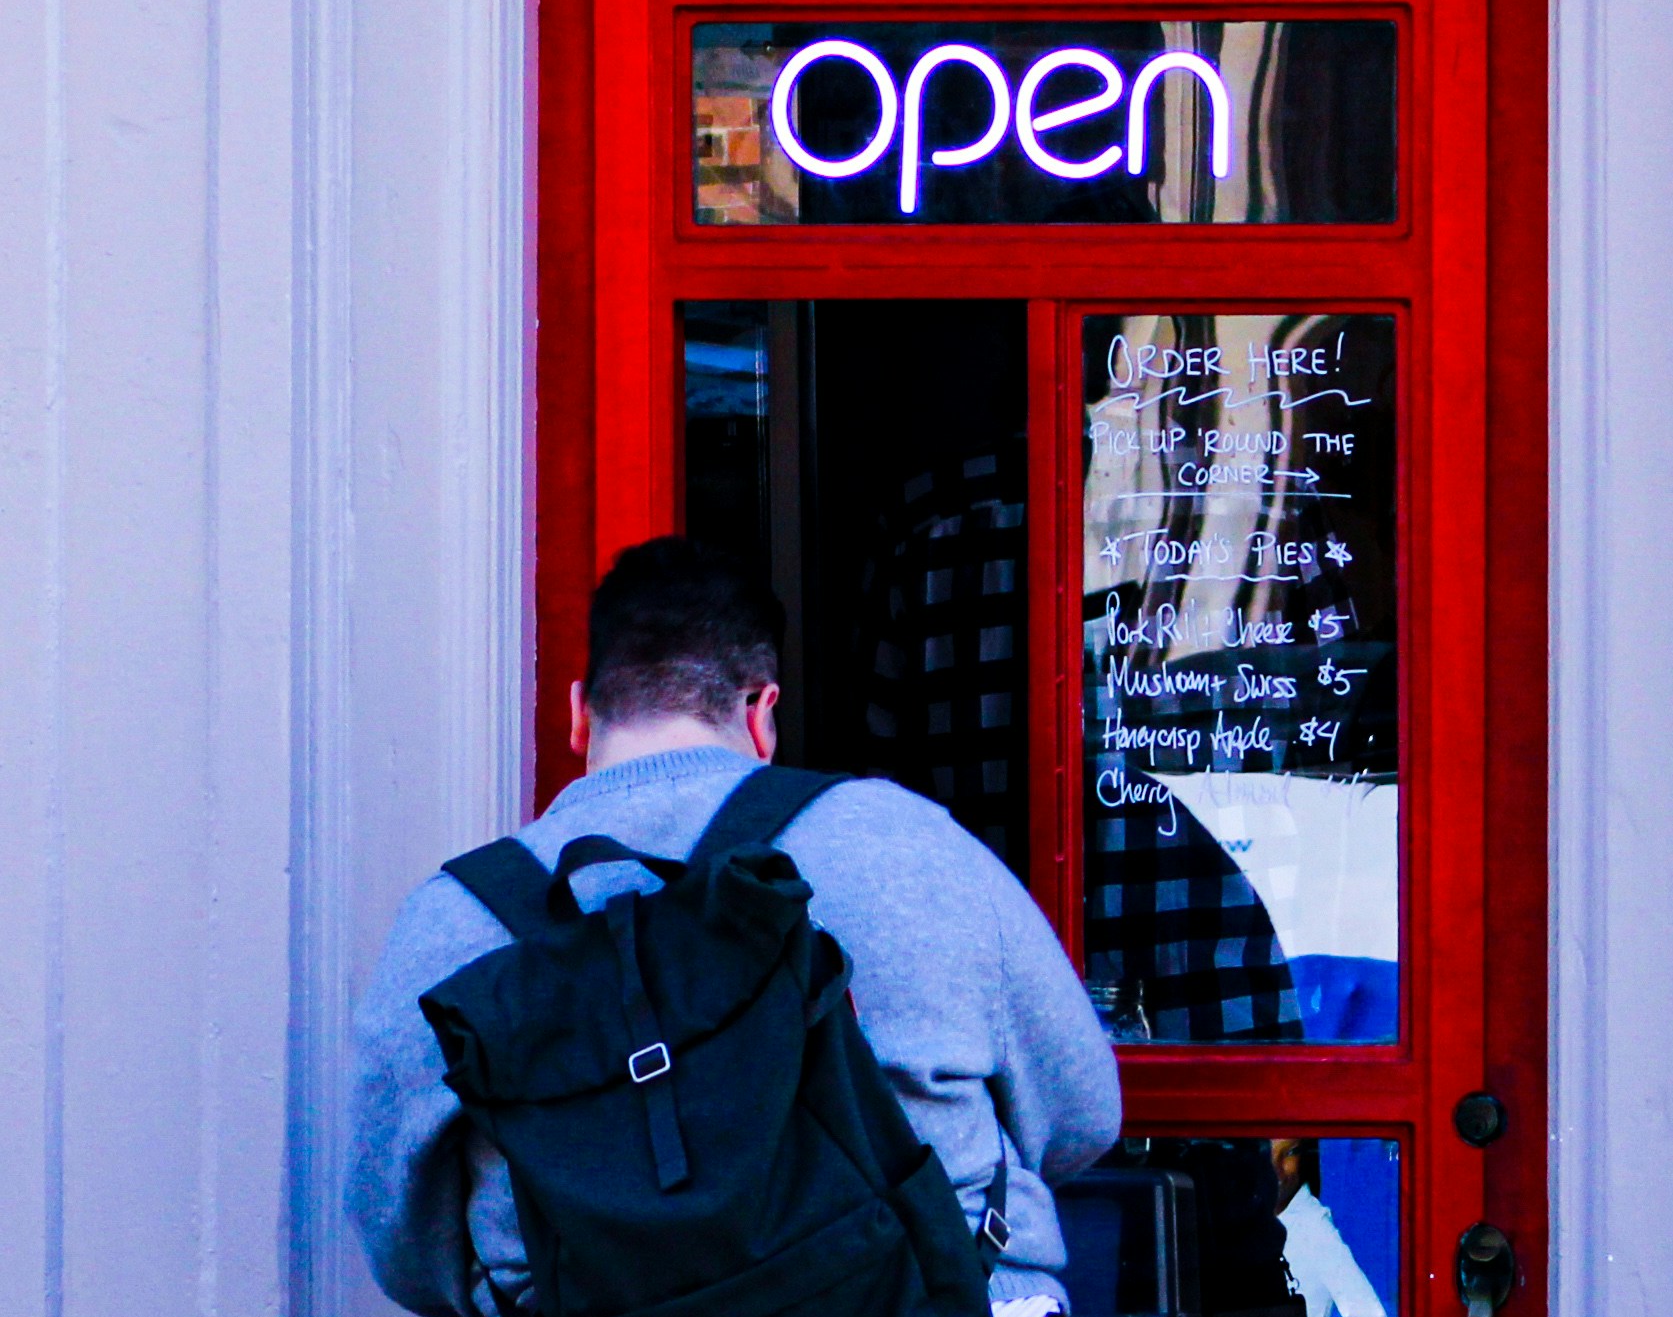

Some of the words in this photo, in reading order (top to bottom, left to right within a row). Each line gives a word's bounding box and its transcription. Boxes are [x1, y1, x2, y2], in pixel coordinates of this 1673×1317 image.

[1107, 334, 1231, 387] ORDER
[1248, 331, 1344, 382] HERE!
[1090, 421, 1140, 455] PICK
[1150, 428, 1186, 453] UP
[1303, 433, 1354, 455] THE
[1178, 462, 1274, 486] CORNER
[1245, 531, 1314, 566] PIES
[1106, 591, 1153, 646] Pork
[1221, 607, 1295, 648] Cheese
[1234, 663, 1297, 702] Swiss
[1210, 710, 1273, 759] Apple
[1096, 767, 1177, 836] Cherry
